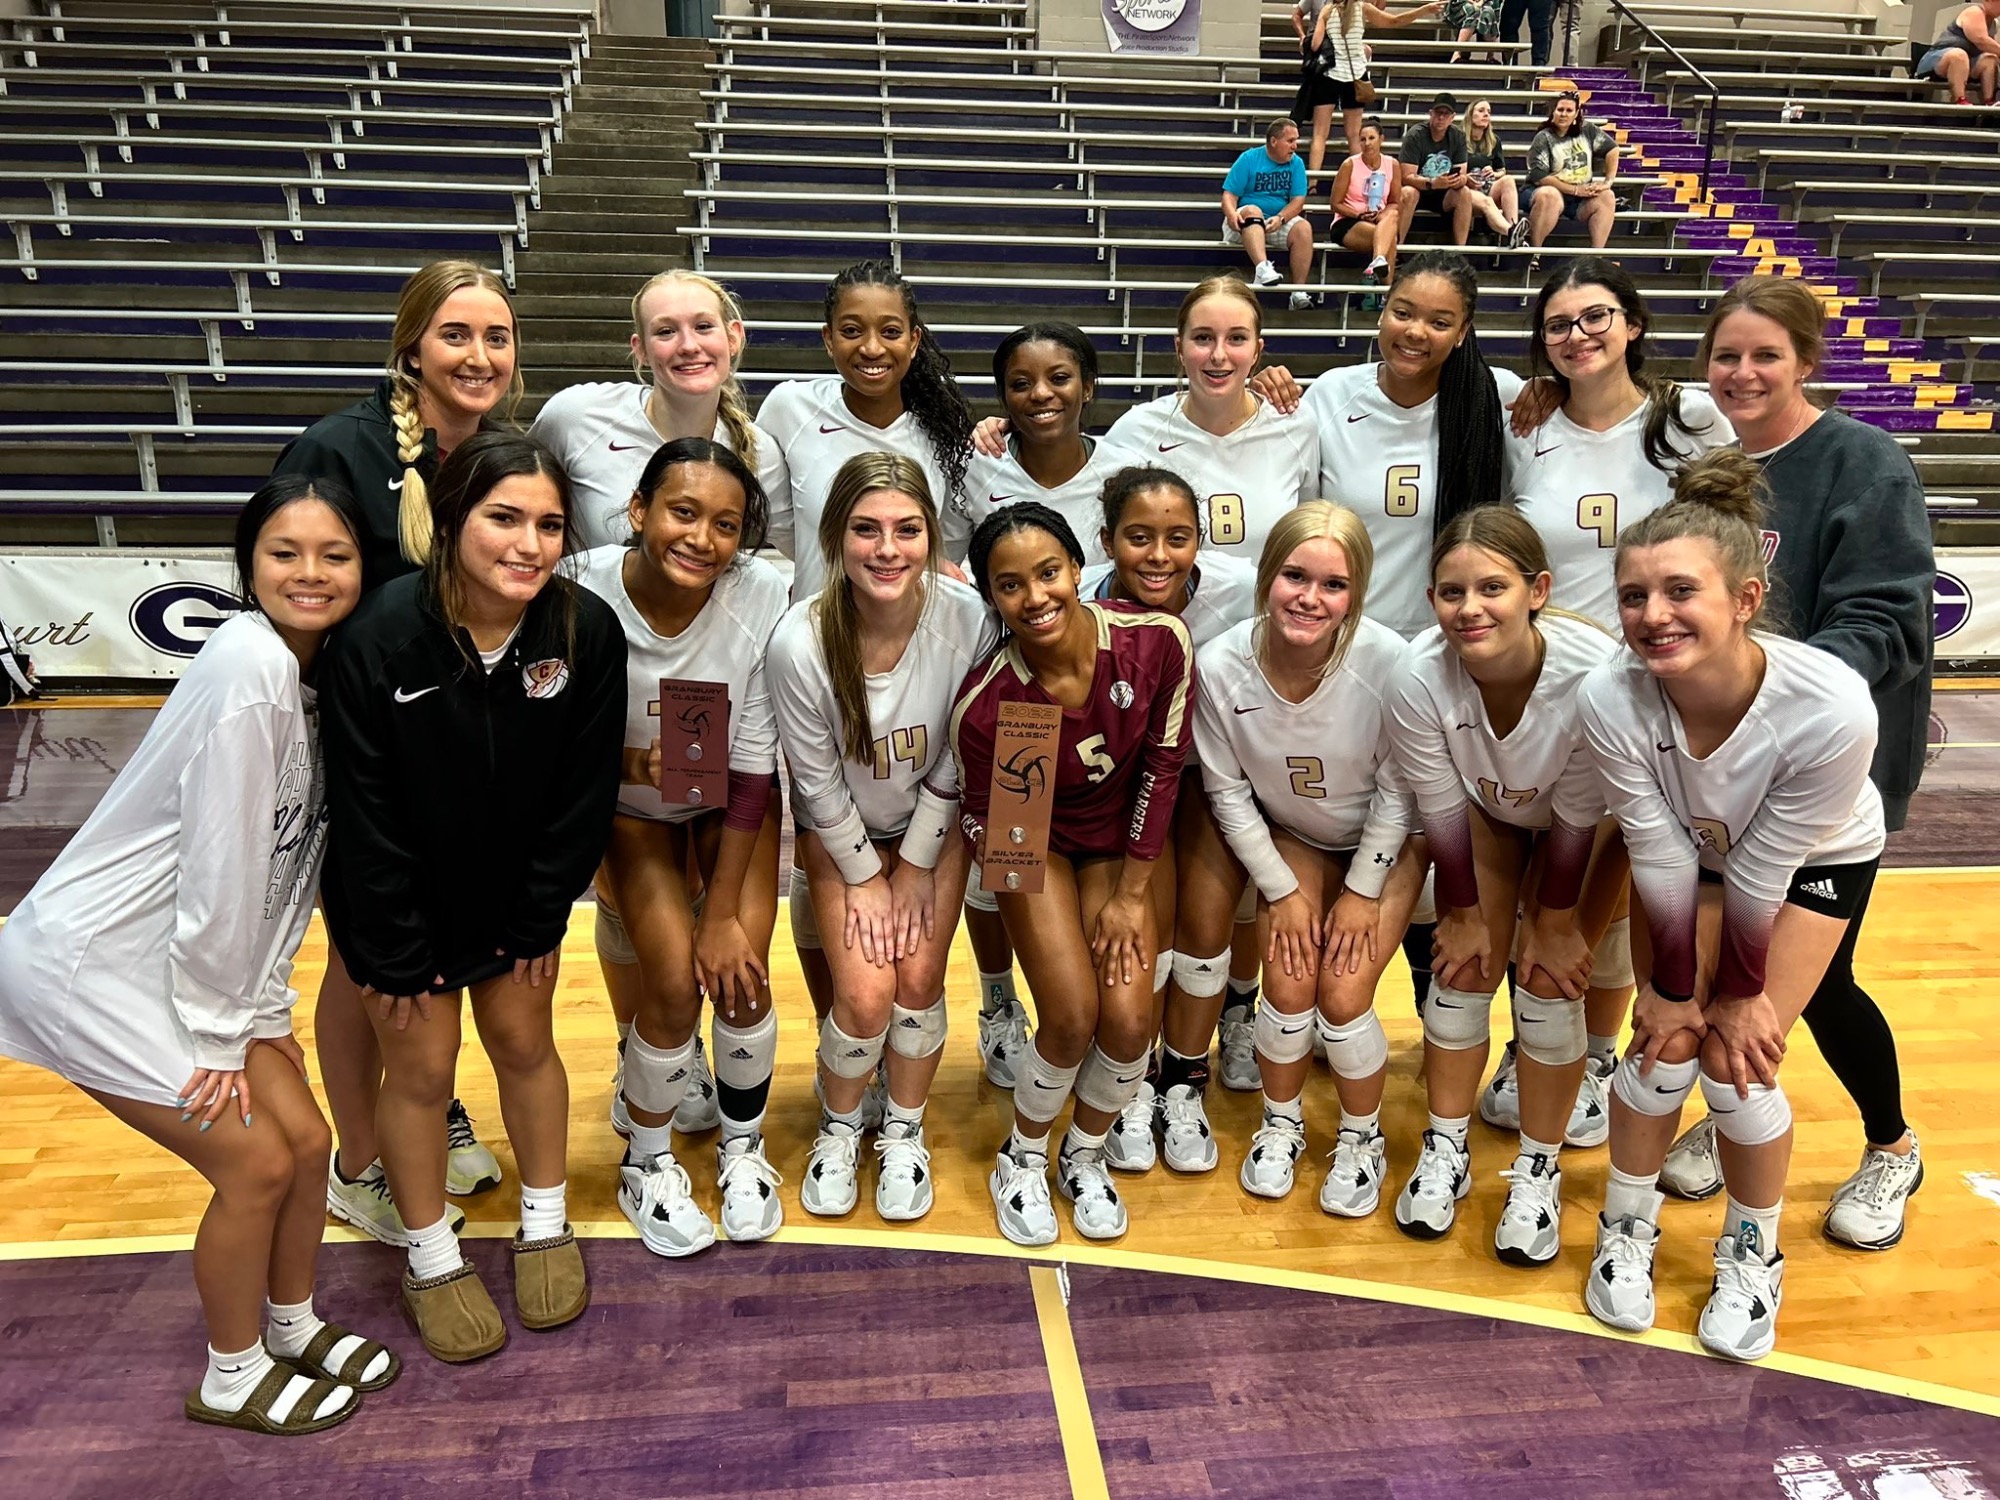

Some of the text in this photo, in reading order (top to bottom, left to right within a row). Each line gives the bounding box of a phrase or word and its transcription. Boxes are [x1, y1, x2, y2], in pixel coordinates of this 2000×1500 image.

[1127, 9, 1177, 19] NETWORK
[1253, 181, 1293, 192] EXCUSES
[1385, 464, 1421, 517] 6
[1208, 493, 1246, 545] 8
[1577, 493, 1617, 548] 9
[13, 611, 94, 646] urt
[539, 664, 550, 679] C
[663, 685, 723, 695] GRANBURY
[671, 693, 716, 703] CLASSIC
[1002, 705, 1056, 720] 2023
[996, 721, 1058, 731] GRANBURY
[1003, 731, 1050, 740] CLASSIC
[873, 723, 928, 779] 14
[1075, 733, 1116, 784] 5
[1286, 756, 1327, 799] 2
[1478, 777, 1539, 808] 17
[1129, 771, 1156, 841] CHARGERS
[985, 858, 1042, 866] BRACKET
[991, 850, 1034, 858] SILVER
[1800, 883, 1838, 900] adidas
